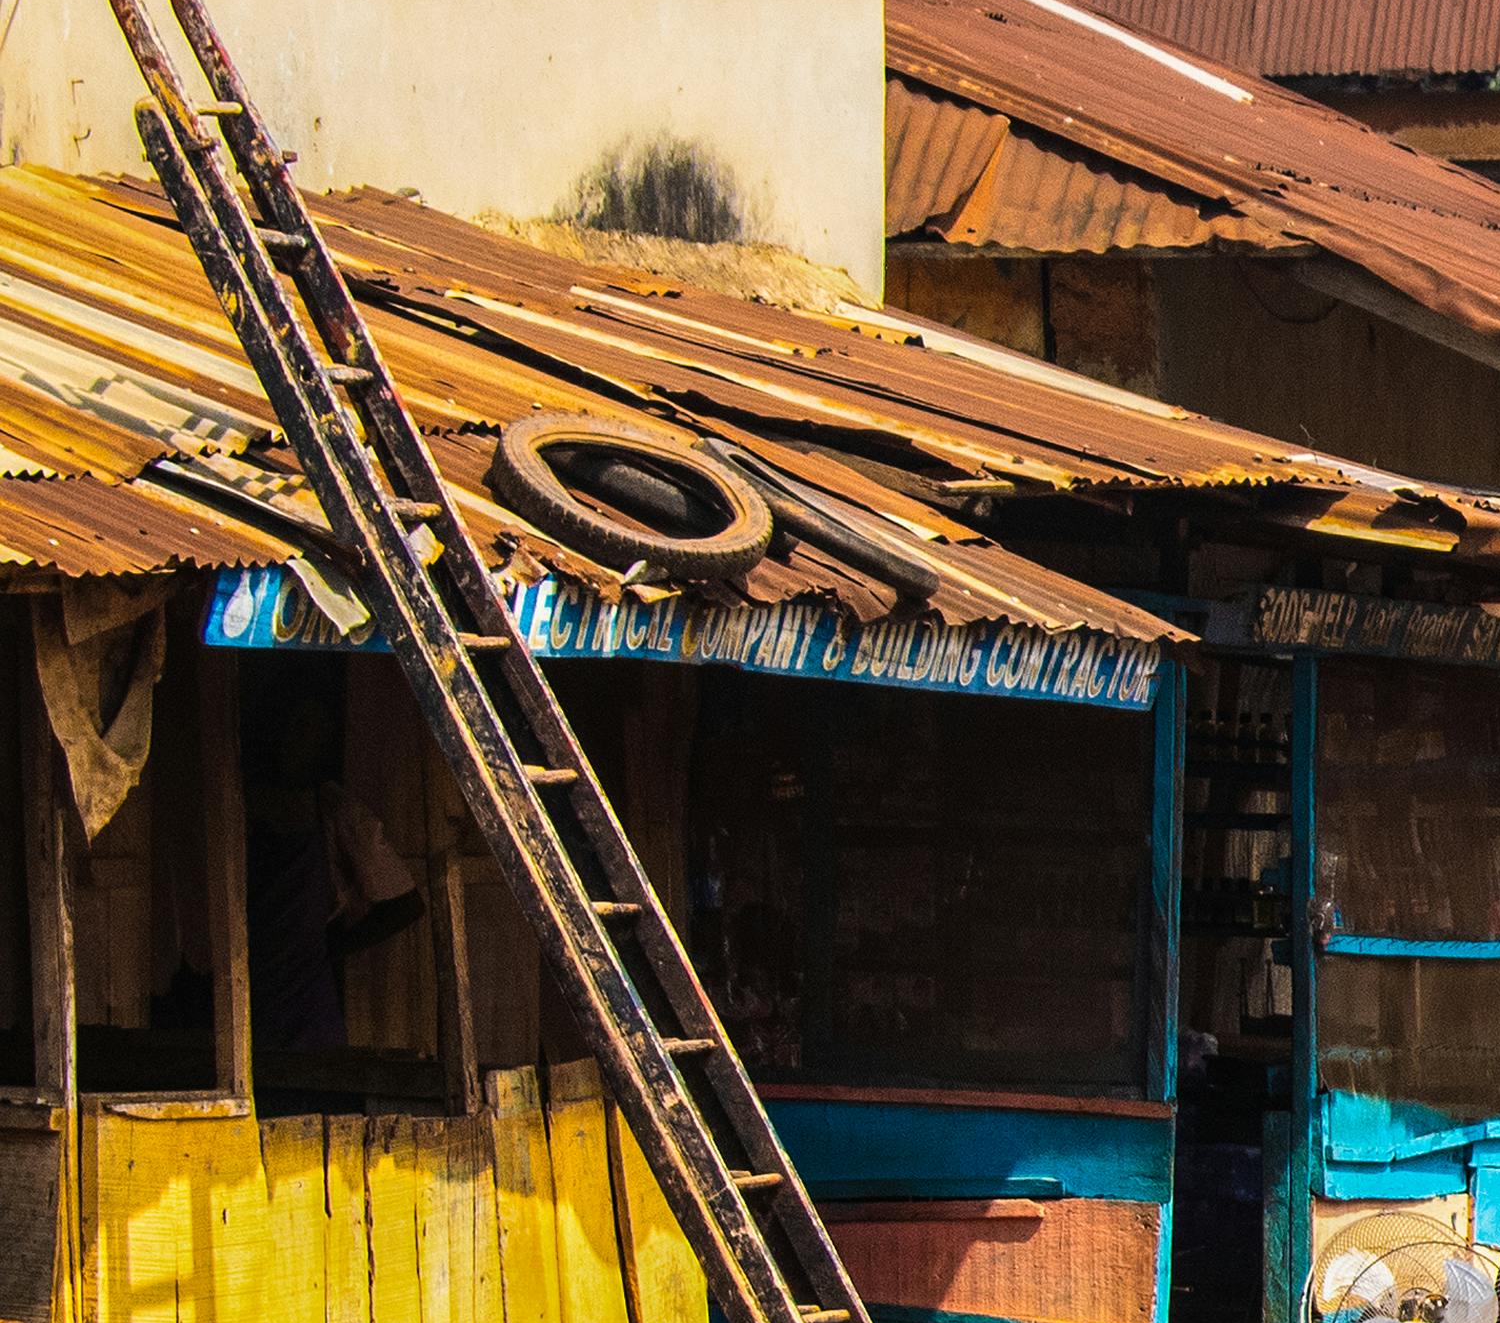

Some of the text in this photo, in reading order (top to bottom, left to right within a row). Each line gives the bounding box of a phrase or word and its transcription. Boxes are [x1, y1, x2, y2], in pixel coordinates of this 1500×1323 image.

[680, 600, 822, 670] COMPANY
[851, 620, 986, 686] BUILDING
[987, 623, 1161, 704] CONTRACTOR
